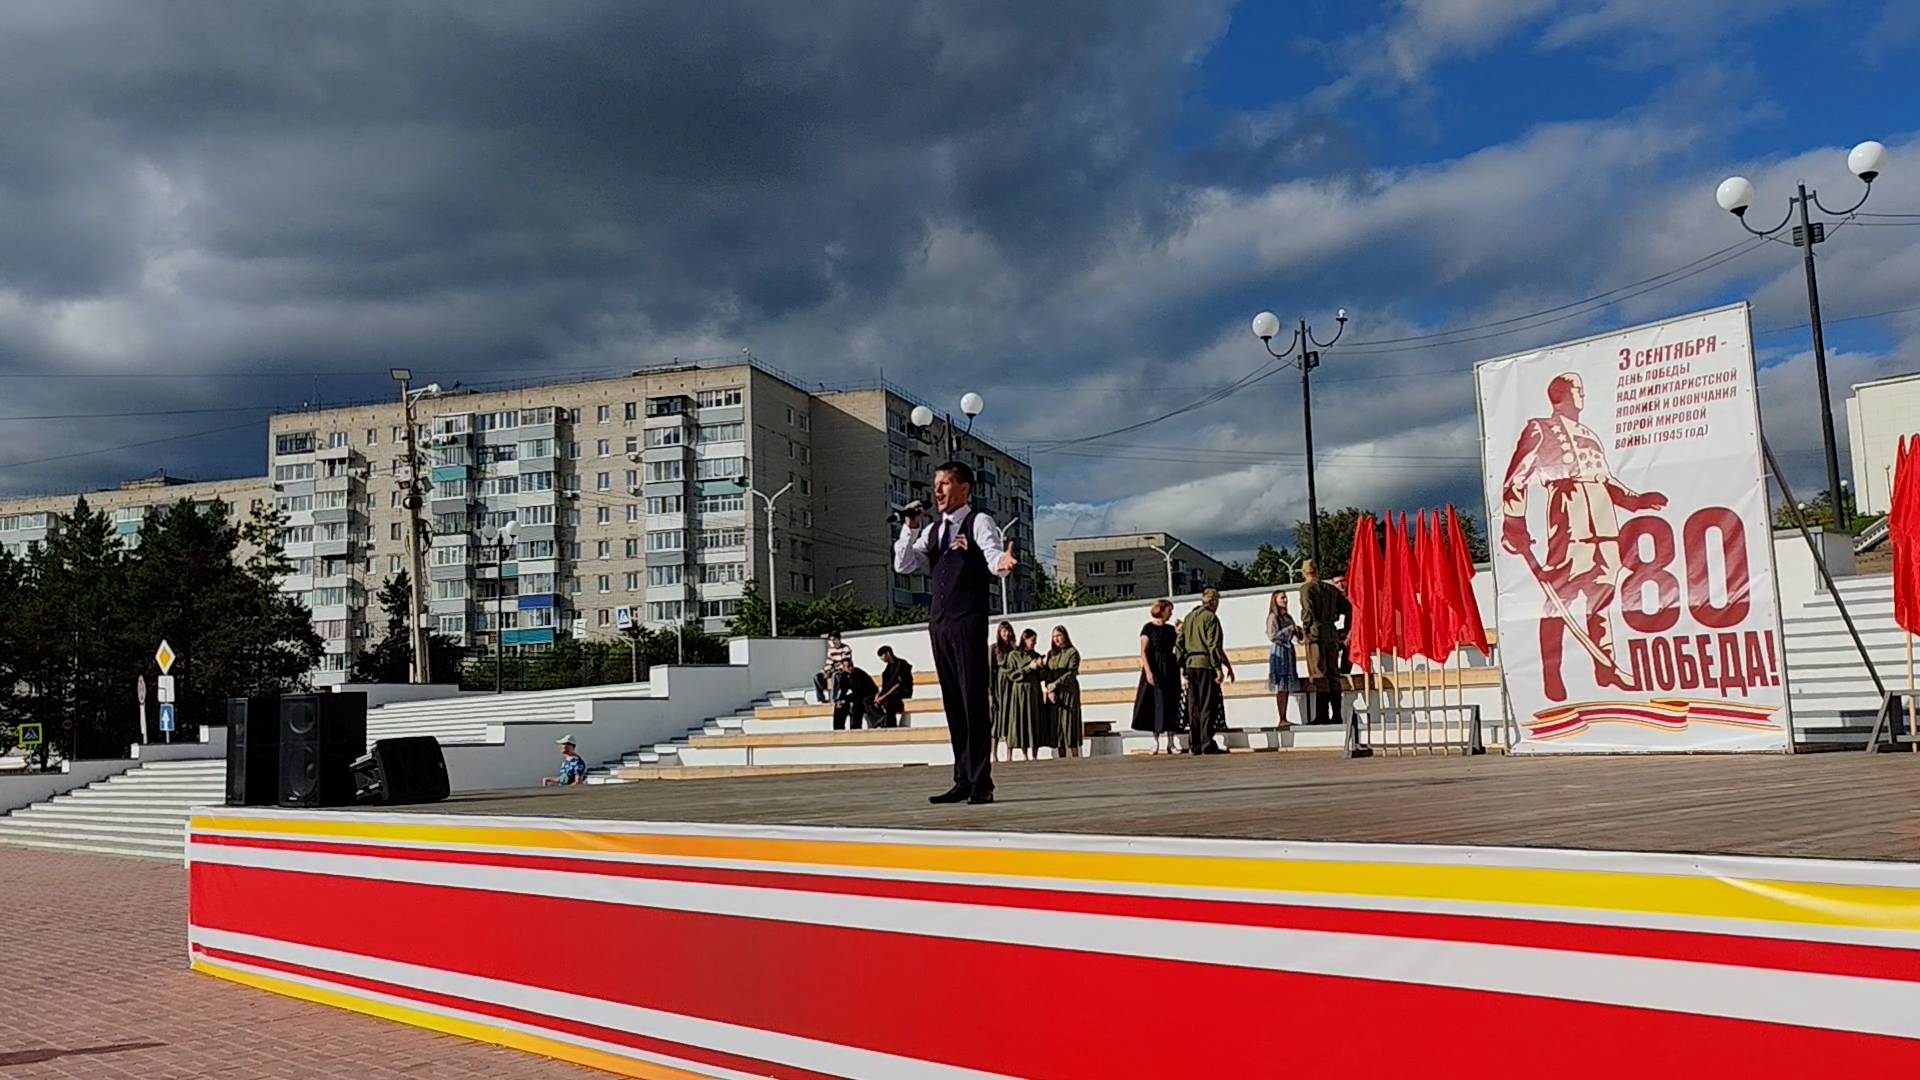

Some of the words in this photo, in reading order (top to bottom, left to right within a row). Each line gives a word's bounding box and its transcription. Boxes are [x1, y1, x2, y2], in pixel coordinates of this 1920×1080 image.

[1618, 348, 1631, 371] 3
[1635, 336, 1717, 368] СЕНТЯБРЯ
[1616, 388, 1637, 403] НАД
[1638, 368, 1737, 398] МИЛИТАРИСТСКОЙ
[1617, 371, 1643, 388] ДЕНЬ
[1645, 362, 1690, 381] ПОБЕДЫ
[1616, 397, 1660, 418] ЯПОНИЕЙ
[1662, 397, 1670, 409] И
[1672, 386, 1737, 407] ОКОНЧАНИЯ
[1615, 415, 1654, 434] ВТОРОЙ
[1656, 405, 1707, 427] МИРОВОЙ
[1615, 432, 1651, 450] ВОЙНЫ
[1653, 429, 1682, 444] (1945
[1618, 506, 1751, 633] 80
[1628, 630, 1780, 697] ПОБЕДА!
